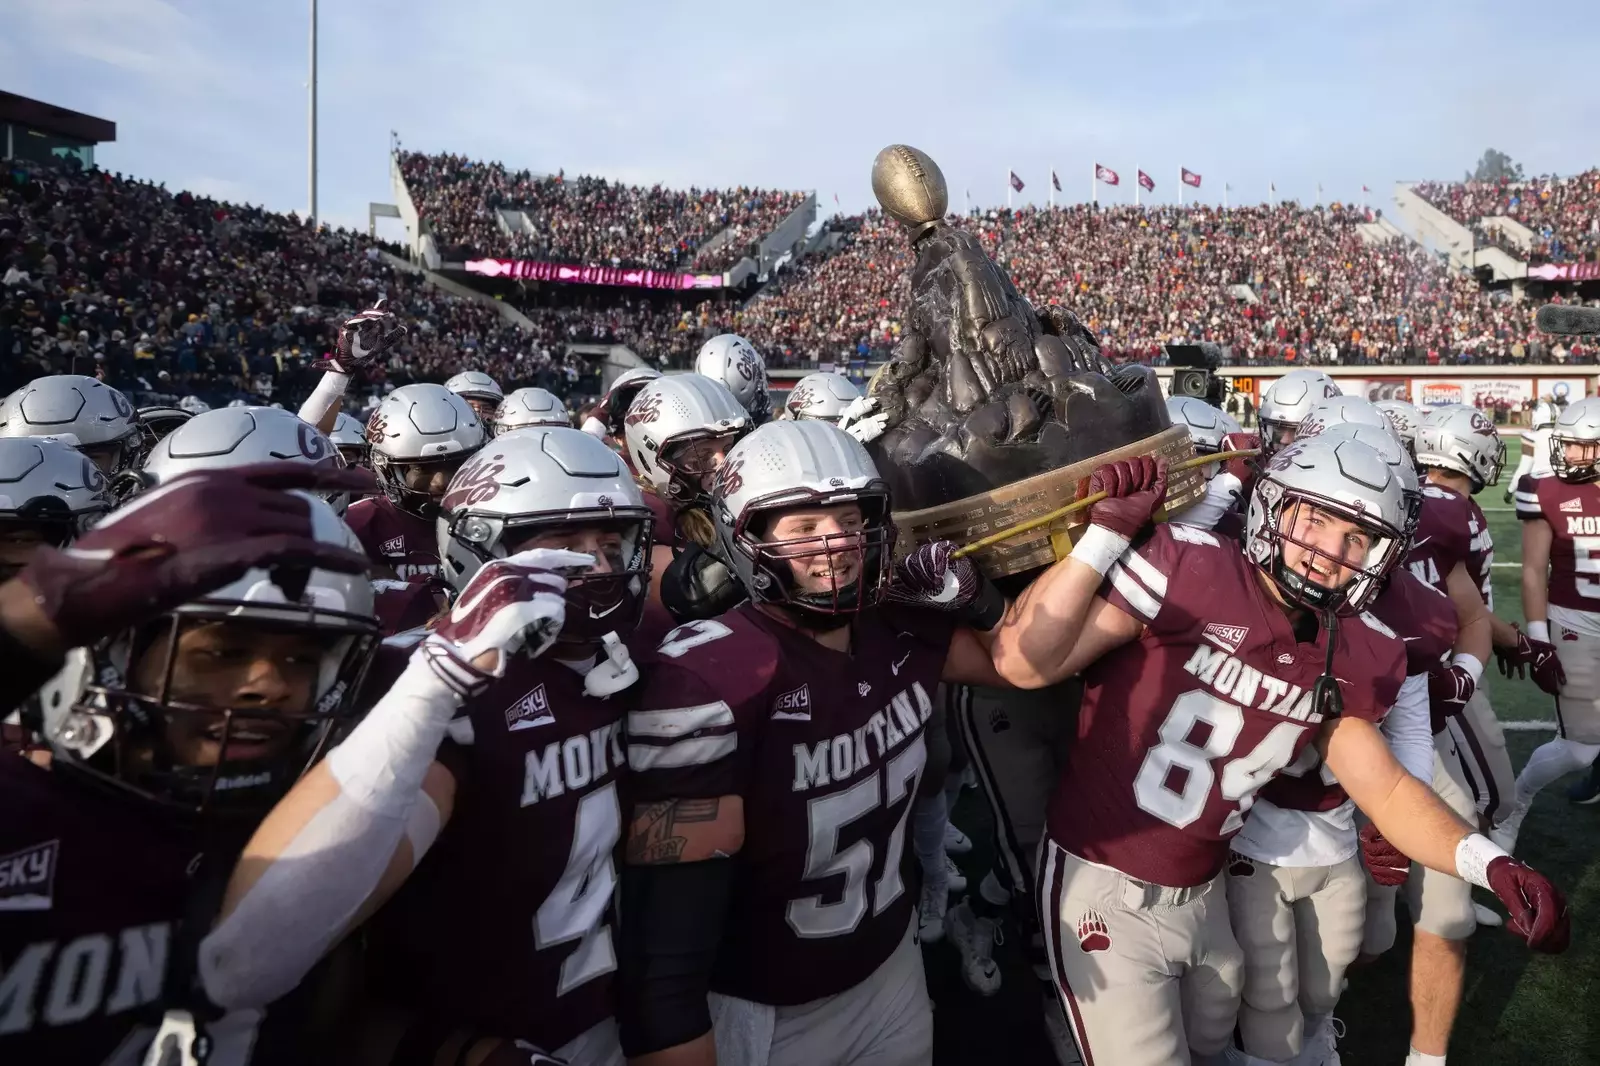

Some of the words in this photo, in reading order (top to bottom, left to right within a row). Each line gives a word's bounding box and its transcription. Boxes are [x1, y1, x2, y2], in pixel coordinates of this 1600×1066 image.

[1233, 378, 1253, 393] 40
[441, 454, 505, 508] riz
[1296, 581, 1323, 599] Rddell
[1133, 688, 1309, 836] 84
[784, 731, 929, 938] 57
[532, 780, 622, 998] 4
